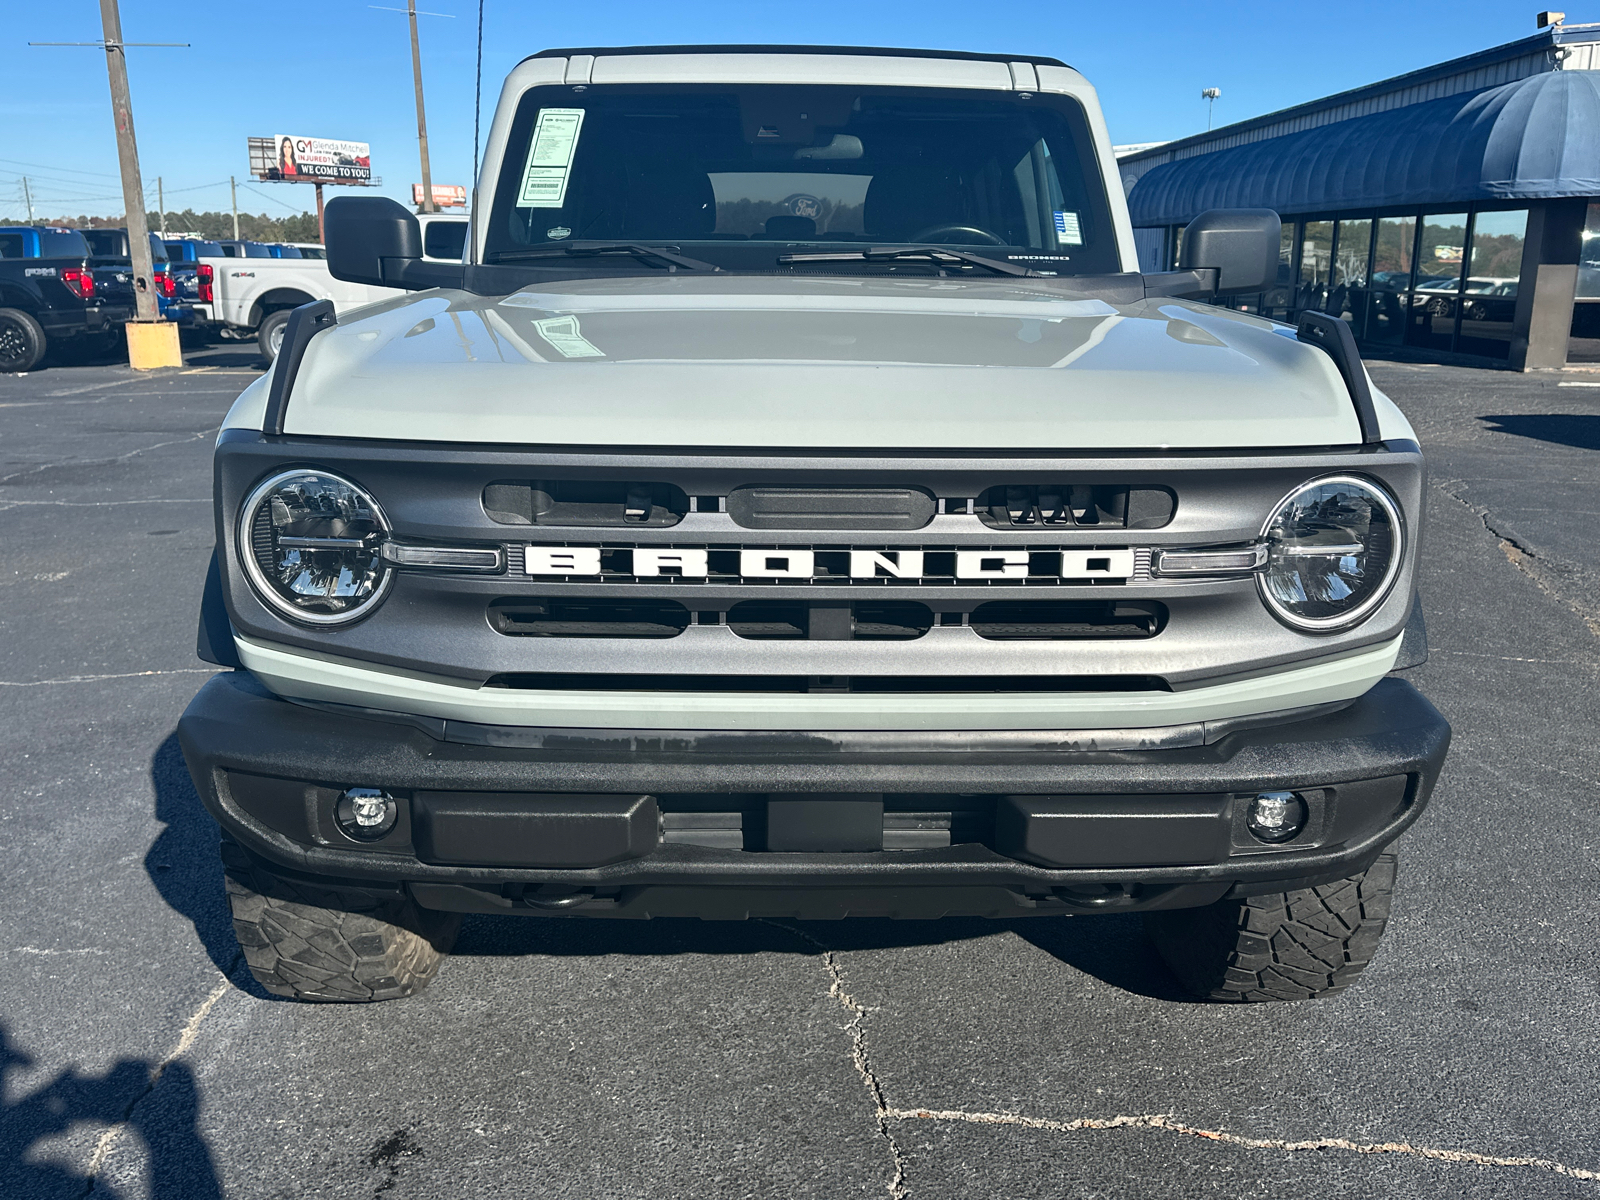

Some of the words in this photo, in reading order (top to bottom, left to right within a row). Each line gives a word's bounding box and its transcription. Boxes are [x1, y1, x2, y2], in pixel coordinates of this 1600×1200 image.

[296, 140, 313, 153] GM
[312, 140, 339, 151] Glenda
[340, 143, 369, 154] Mitchell
[297, 154, 331, 163] INJURED?
[301, 164, 314, 174] WE
[315, 165, 339, 176] COME
[339, 168, 351, 177] TO
[351, 168, 370, 178] YOU!
[795, 199, 818, 217] Ford
[525, 547, 1134, 579] BRONCO
